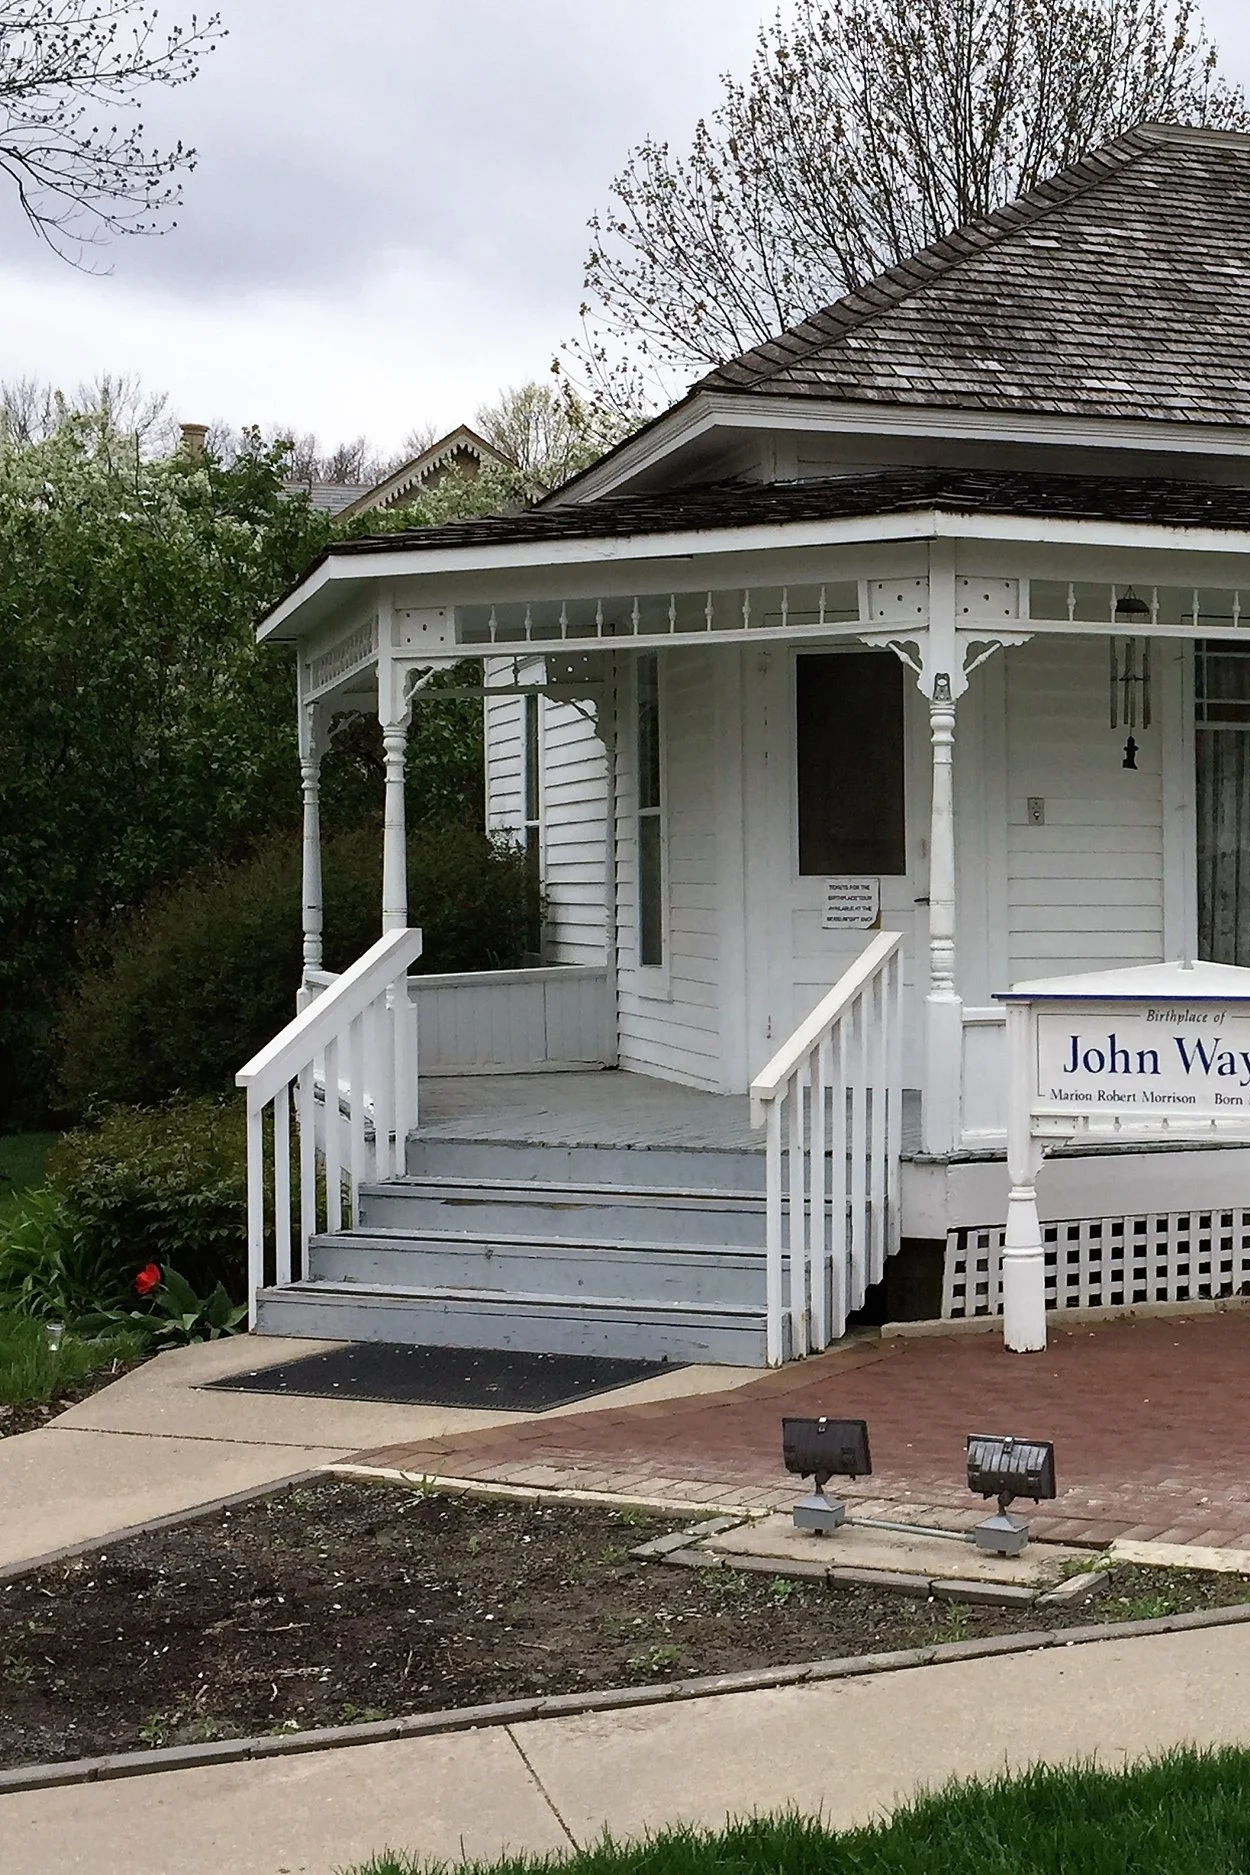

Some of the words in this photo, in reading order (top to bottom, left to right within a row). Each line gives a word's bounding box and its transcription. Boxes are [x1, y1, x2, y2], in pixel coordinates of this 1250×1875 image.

[1146, 1008, 1207, 1026] Birthplace
[1212, 1009, 1228, 1025] of
[1063, 1032, 1162, 1075] John
[1050, 1088, 1092, 1101] Marion
[1097, 1089, 1136, 1102] Robert
[1141, 1091, 1196, 1104] Morrison
[1213, 1092, 1243, 1106] Born
